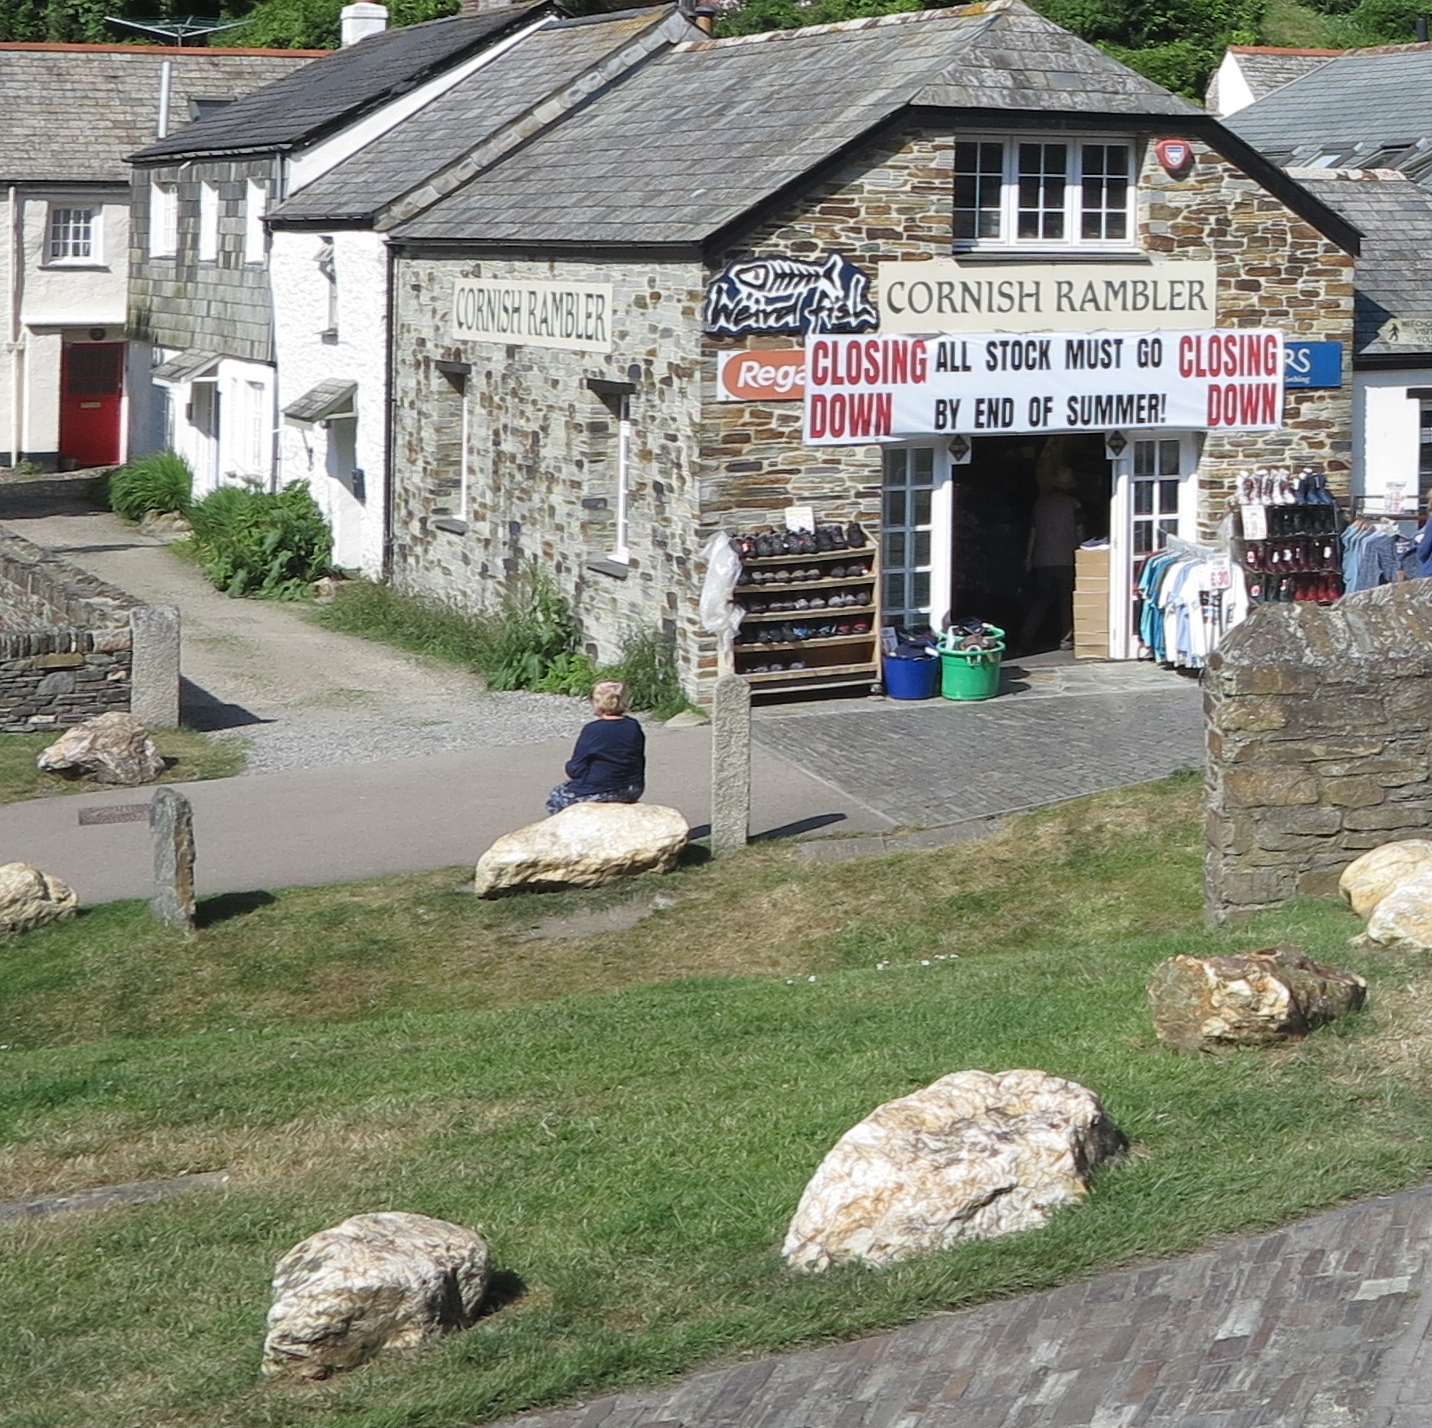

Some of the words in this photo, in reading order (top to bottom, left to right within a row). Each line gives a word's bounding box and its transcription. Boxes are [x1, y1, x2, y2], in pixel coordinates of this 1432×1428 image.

[456, 286, 522, 335] CORNISH
[527, 290, 607, 342] RAMBLER
[886, 280, 1043, 314] CORNISH
[1054, 279, 1209, 312] RAMBLER
[811, 339, 928, 386] CLOSING
[935, 341, 972, 372] ALL
[986, 339, 1053, 372] STOCK
[1065, 338, 1123, 370] MUST
[1137, 337, 1163, 369] GO
[1179, 334, 1278, 379] CLOSING
[809, 392, 893, 439] DOWN
[934, 398, 961, 431] BY
[974, 397, 1015, 429] END
[1028, 396, 1054, 428] OF
[1066, 393, 1167, 426] SUMMER!
[1207, 382, 1278, 427] DOWN
